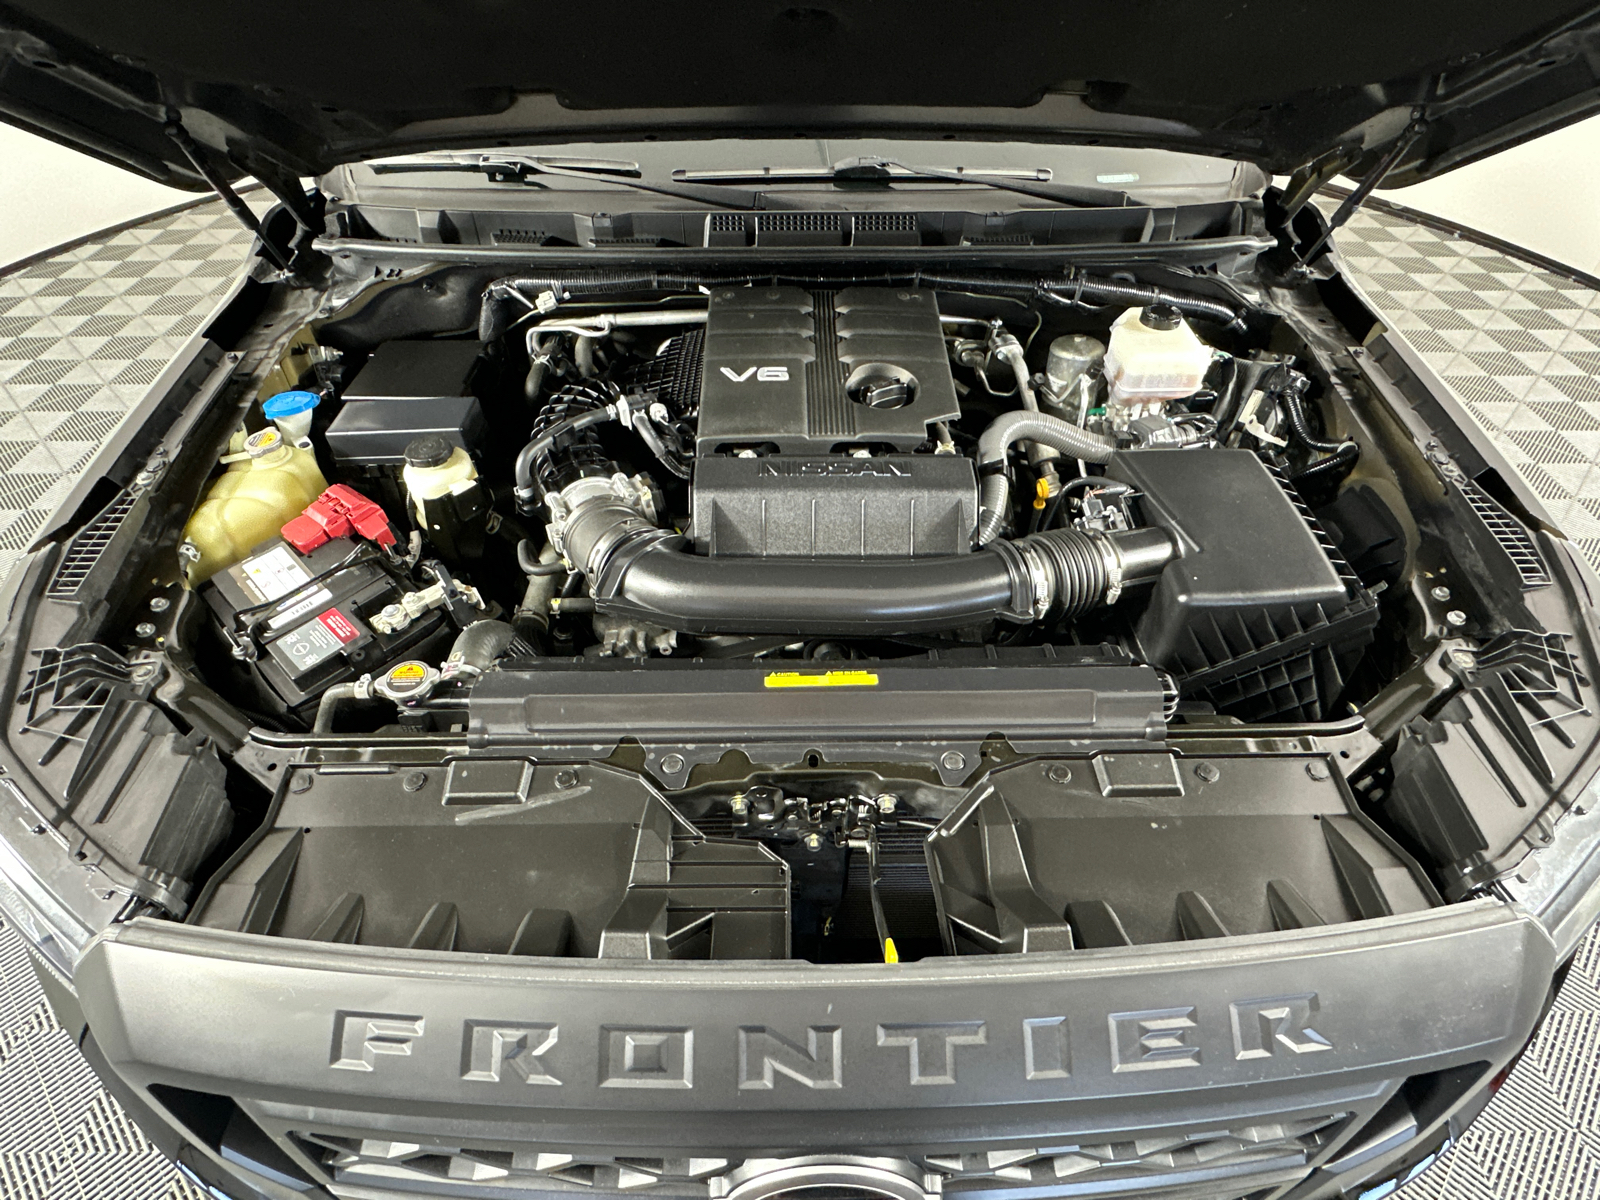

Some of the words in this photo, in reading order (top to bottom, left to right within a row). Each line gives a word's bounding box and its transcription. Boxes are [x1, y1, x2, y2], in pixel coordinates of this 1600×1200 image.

[720, 366, 790, 382] V6
[758, 460, 912, 477] NISSAN
[329, 991, 1334, 1090] FRONTIER
